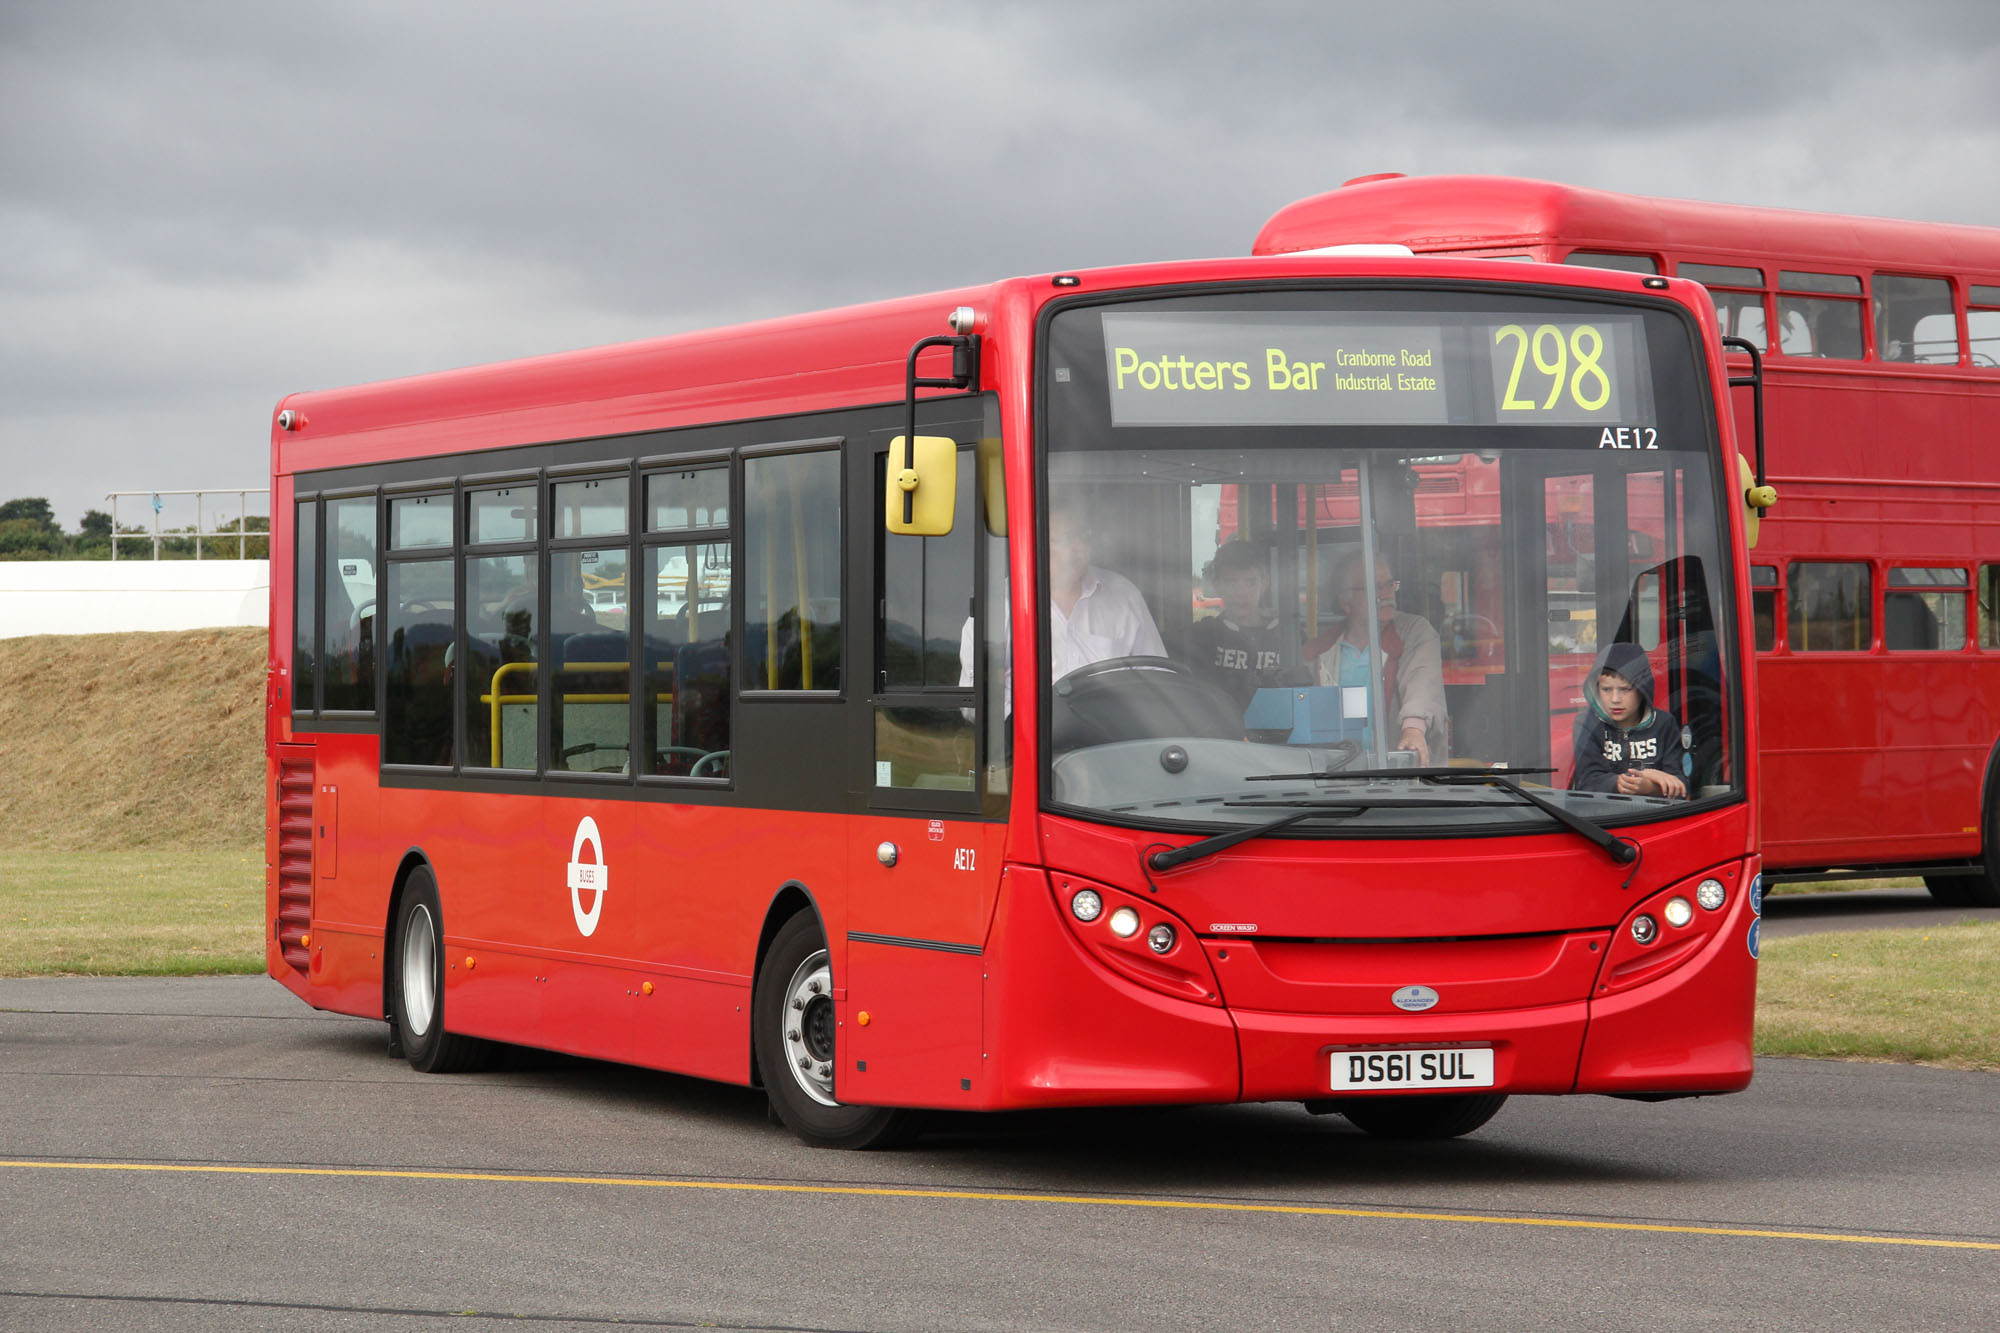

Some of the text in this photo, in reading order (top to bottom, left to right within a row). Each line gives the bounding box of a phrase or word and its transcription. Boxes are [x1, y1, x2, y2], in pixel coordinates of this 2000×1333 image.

[1114, 347, 1326, 390] Potters Bar
[1336, 349, 1432, 367] Cranborne Road
[1495, 324, 1610, 411] 298
[1335, 373, 1436, 391] Industrial Estate
[1599, 427, 1659, 450] AE12
[953, 848, 976, 871] AE12
[579, 869, 595, 884] BUSES
[1349, 1052, 1475, 1083] DS61 SUL
